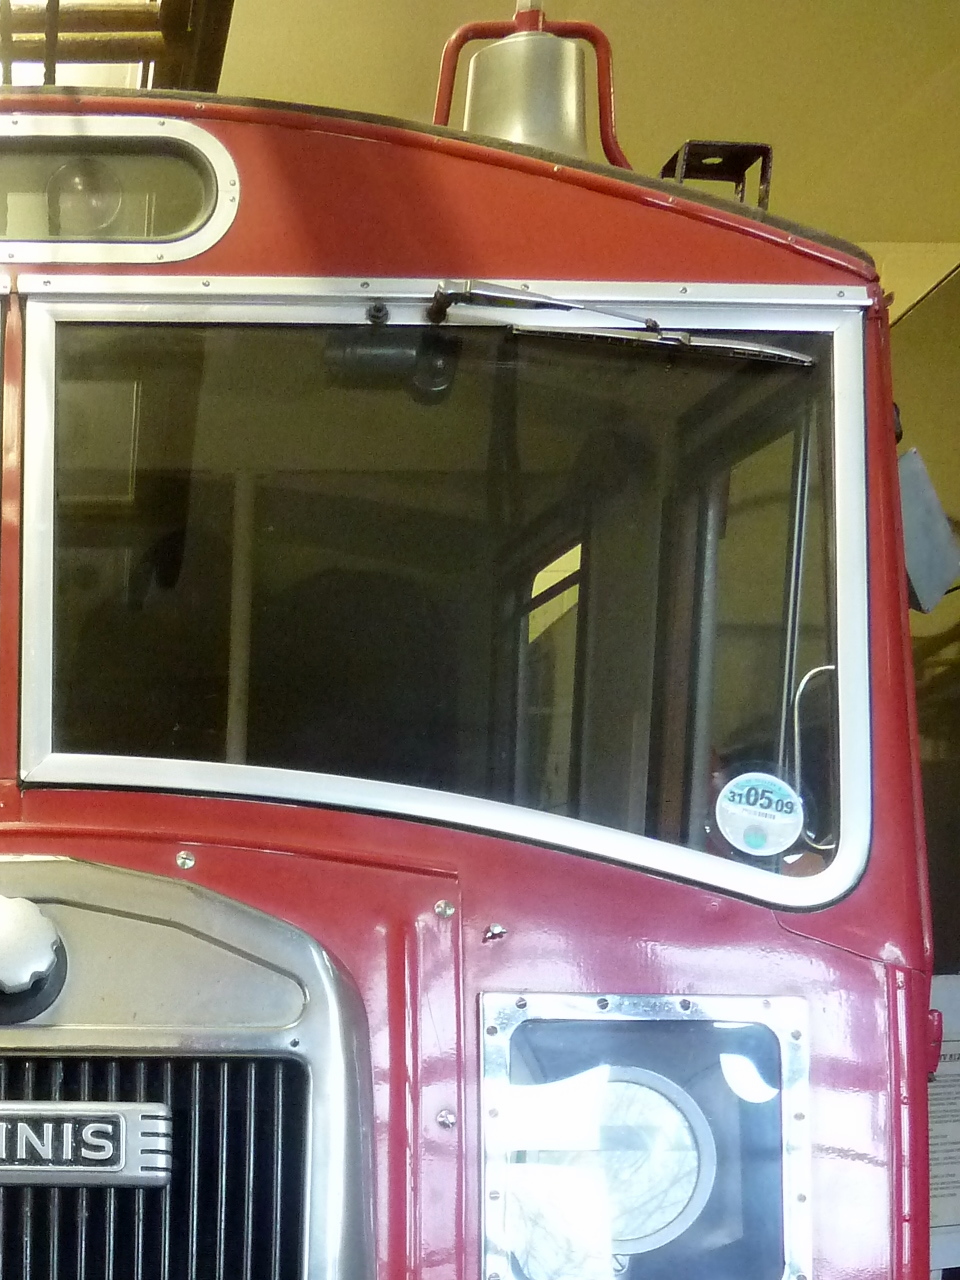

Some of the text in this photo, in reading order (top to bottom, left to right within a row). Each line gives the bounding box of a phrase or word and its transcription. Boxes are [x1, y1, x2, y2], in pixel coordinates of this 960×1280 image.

[728, 791, 742, 804] 31
[745, 786, 773, 809] 05
[775, 798, 794, 814] 09
